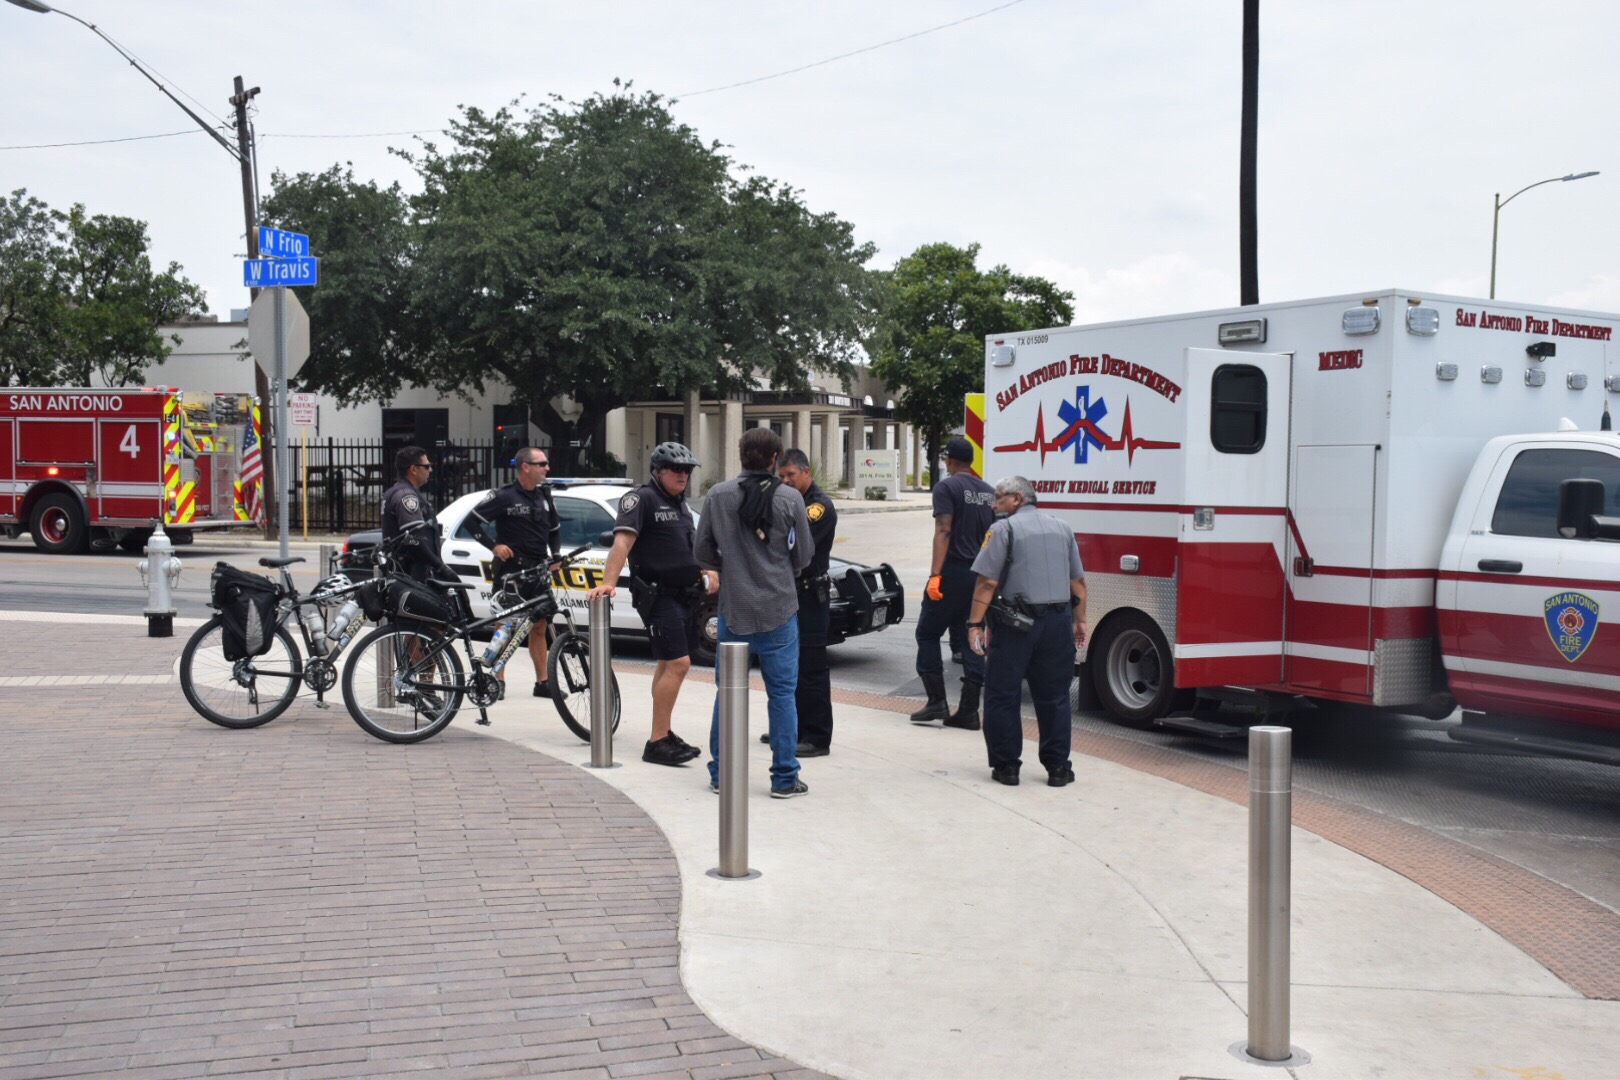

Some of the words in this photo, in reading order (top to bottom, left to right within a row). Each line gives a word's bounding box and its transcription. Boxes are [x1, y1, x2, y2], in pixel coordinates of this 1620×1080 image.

[265, 230, 274, 249] N
[279, 232, 302, 254] Frio
[250, 261, 262, 280] W
[267, 258, 310, 279] Travis
[1017, 337, 1026, 346] TX
[1026, 334, 1049, 346] 015009
[1318, 349, 1363, 371] MEDIC
[9, 395, 42, 411] SAN
[46, 395, 123, 412] ANTONIO
[119, 424, 141, 459] 4
[1030, 480, 1067, 493] RGENCY
[1067, 480, 1109, 494] MEDICAL
[1112, 481, 1156, 494] SERVICE
[507, 506, 530, 516] POLICE
[654, 511, 680, 522] POLICE
[1545, 594, 1560, 611] SAN
[1562, 593, 1598, 615] ANTONIO
[1560, 635, 1581, 646] FIRE
